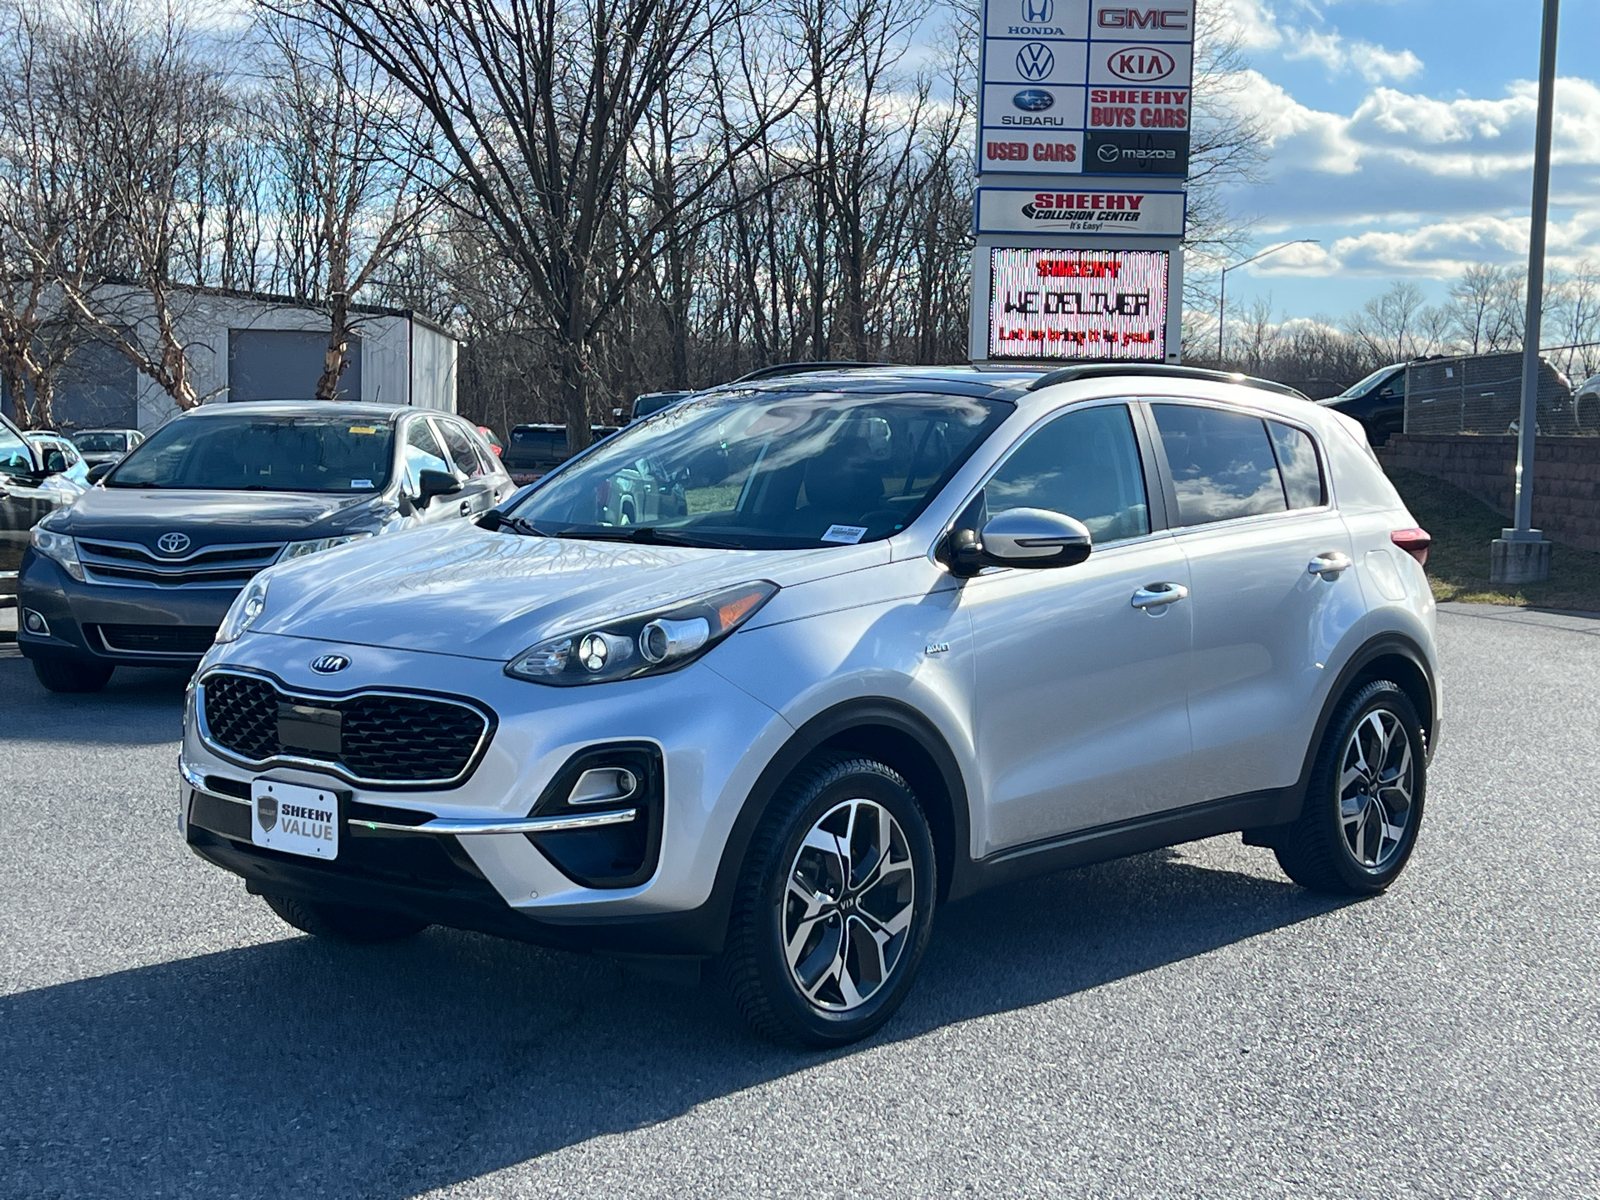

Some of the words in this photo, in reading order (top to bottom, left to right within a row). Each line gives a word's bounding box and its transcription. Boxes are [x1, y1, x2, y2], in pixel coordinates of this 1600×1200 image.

[1098, 7, 1188, 30] GMC
[1007, 26, 1065, 36] HONDA
[1119, 54, 1164, 74] KIA
[1090, 90, 1188, 104] SHEEHY
[1001, 116, 1064, 126] SUBARU
[1091, 107, 1136, 127] BUYS
[1140, 108, 1187, 128] CARS
[986, 142, 1028, 161] USED
[1033, 143, 1076, 162] CARS
[1122, 148, 1176, 159] mazda
[1035, 194, 1144, 210] SHEEHY
[1034, 210, 1095, 220] COLLISION
[1096, 211, 1142, 222] CENTER
[1070, 222, 1080, 230] It's
[1082, 222, 1104, 232] Easy!
[1005, 291, 1040, 314] WE
[1044, 291, 1150, 316] DELIVER
[999, 327, 1025, 340] Let
[314, 656, 344, 670] KIA
[282, 804, 332, 823] SHEEHY
[282, 817, 332, 841] VALUE
